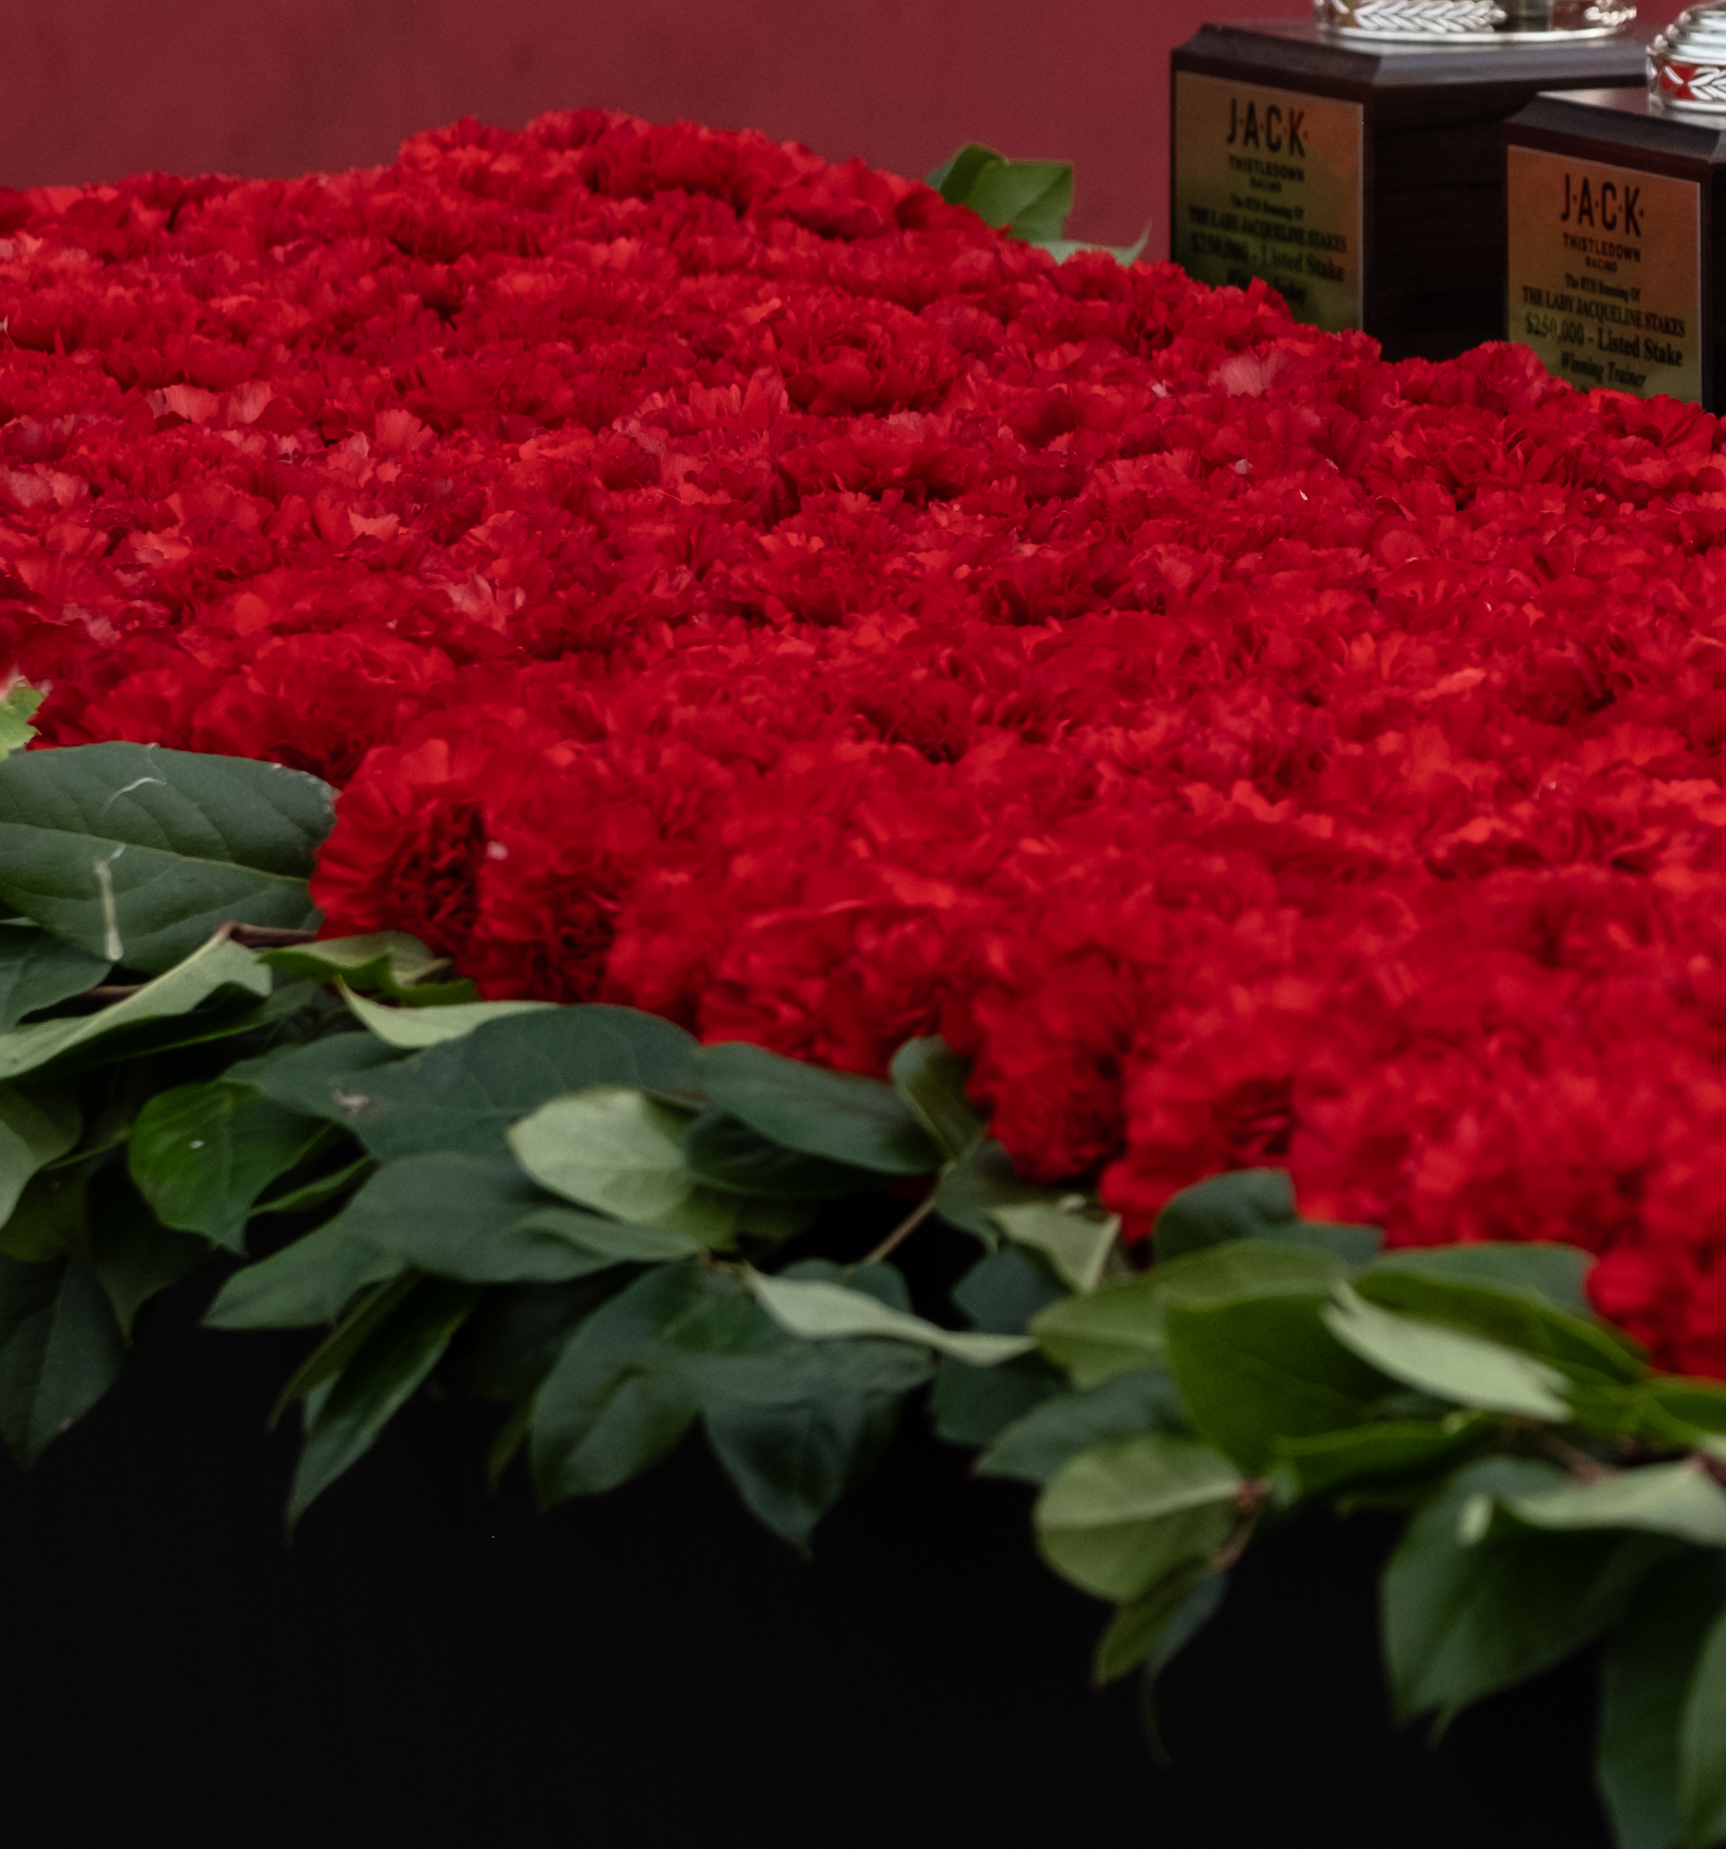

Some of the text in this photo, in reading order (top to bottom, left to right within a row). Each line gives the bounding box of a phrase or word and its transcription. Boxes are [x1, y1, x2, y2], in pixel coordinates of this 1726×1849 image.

[1227, 99, 1306, 157] JACK
[1561, 173, 1641, 237] JACK
[1563, 233, 1641, 262] THISTLEDOWN
[1586, 259, 1617, 273] RACINO
[1565, 273, 1579, 288] The
[1598, 281, 1629, 304] Running
[1630, 286, 1640, 303] Of
[1522, 286, 1686, 338] THE LADY JACQUELINE STAKES
[1526, 312, 1584, 346] $250,000
[1597, 328, 1640, 358] Listed
[1644, 338, 1683, 367] Stake
[1561, 351, 1604, 384] Winning
